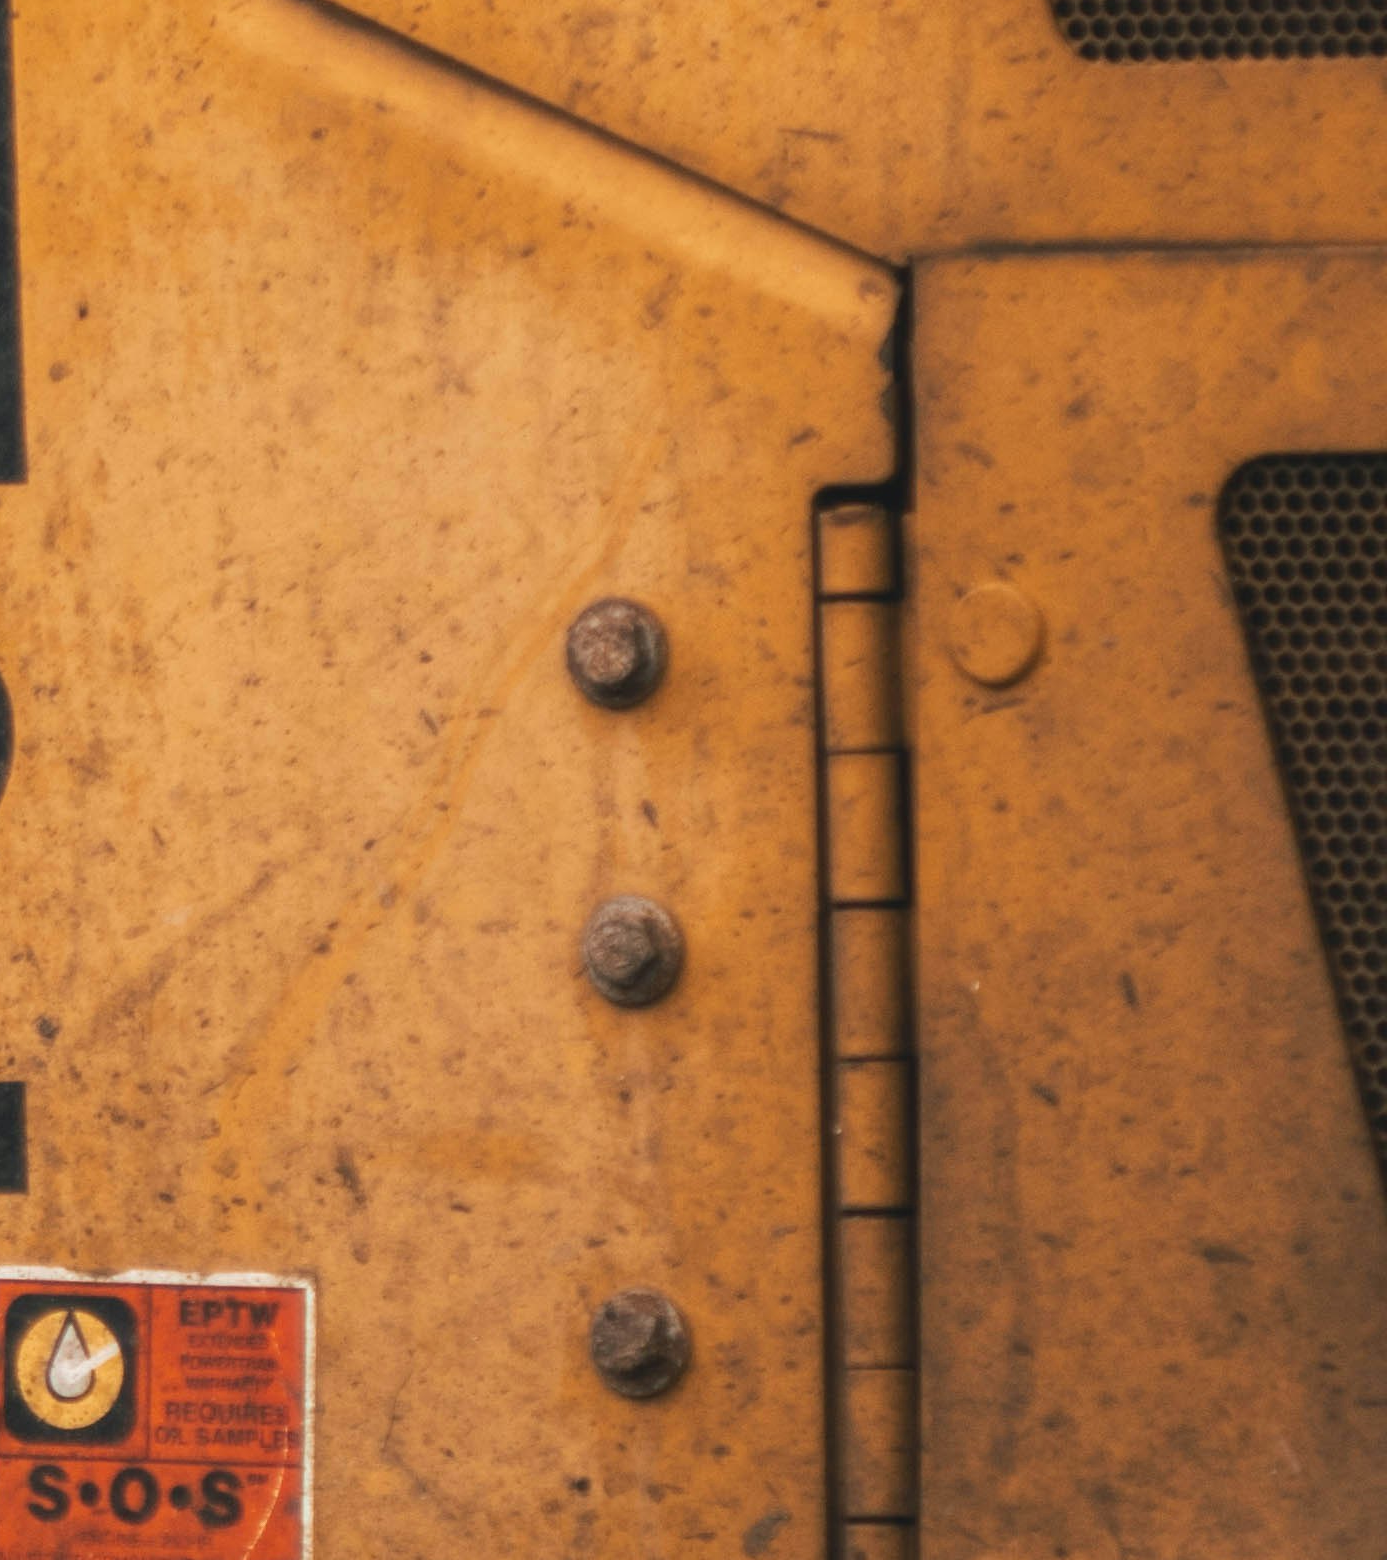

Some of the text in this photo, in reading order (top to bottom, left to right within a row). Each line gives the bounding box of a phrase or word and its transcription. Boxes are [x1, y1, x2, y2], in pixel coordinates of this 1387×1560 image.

[179, 1297, 280, 1328] EPTW
[164, 1400, 291, 1426] REQUIRES
[195, 1428, 301, 1451] SAMPLES
